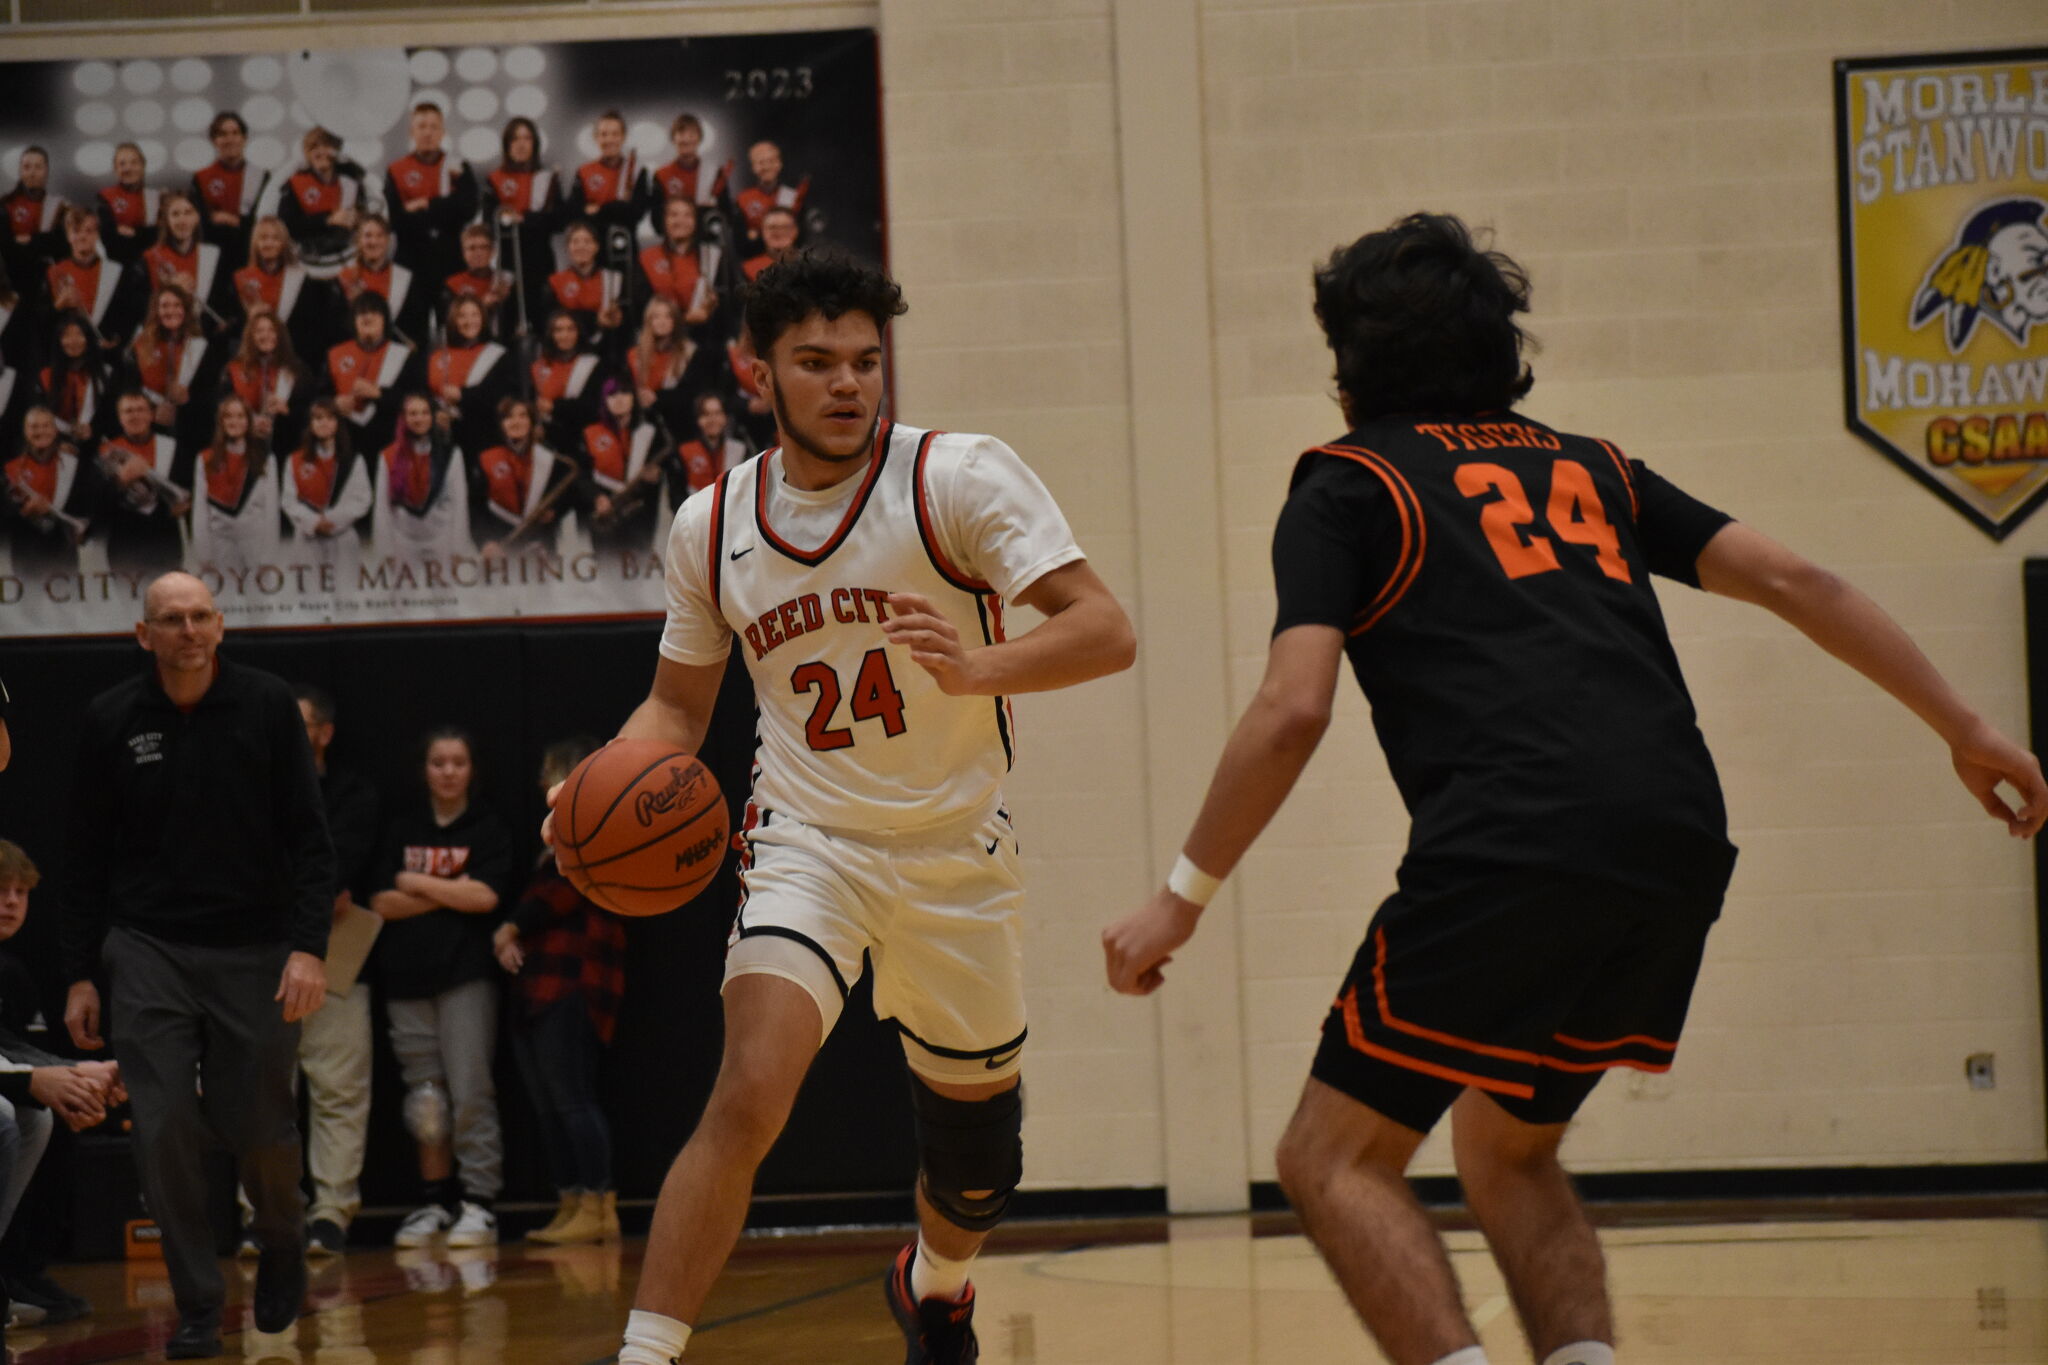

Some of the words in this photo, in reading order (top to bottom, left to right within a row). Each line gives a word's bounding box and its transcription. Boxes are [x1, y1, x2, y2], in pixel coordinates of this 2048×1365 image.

[724, 67, 814, 100] 2023
[1414, 422, 1562, 451] TIGERS
[1453, 459, 1633, 584] 24
[44, 569, 147, 603] CITY
[190, 562, 335, 597] OYOTE
[357, 551, 598, 591] MARCHING
[621, 551, 667, 581] BA
[744, 592, 825, 661] REED
[830, 587, 897, 624] CIT
[790, 647, 907, 751] 24
